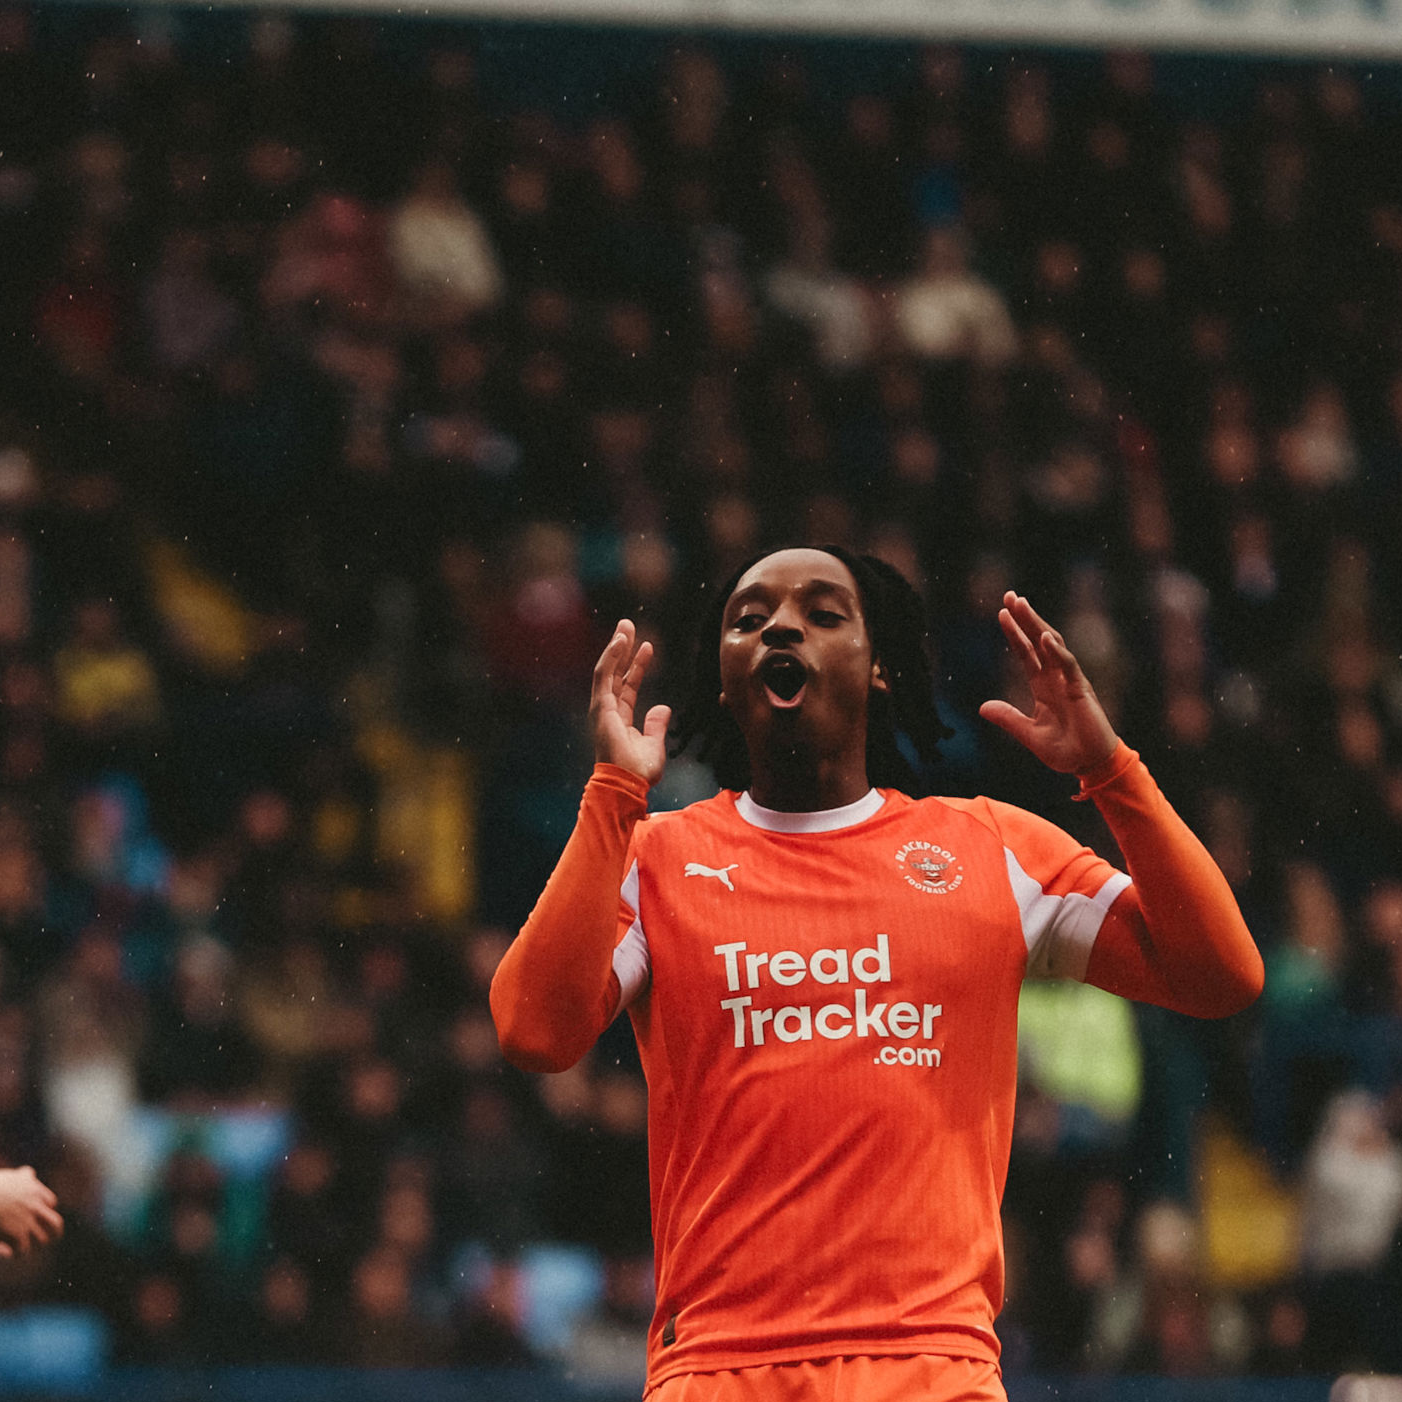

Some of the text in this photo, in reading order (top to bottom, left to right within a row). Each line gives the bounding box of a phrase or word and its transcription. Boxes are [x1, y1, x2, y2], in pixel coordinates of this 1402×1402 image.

[894, 840, 957, 863] BLACKPOOL
[904, 874, 964, 895] FOOTBALL CLUB
[714, 934, 891, 992] Tread
[720, 988, 943, 1049] Tracker
[873, 1045, 942, 1068] .com
